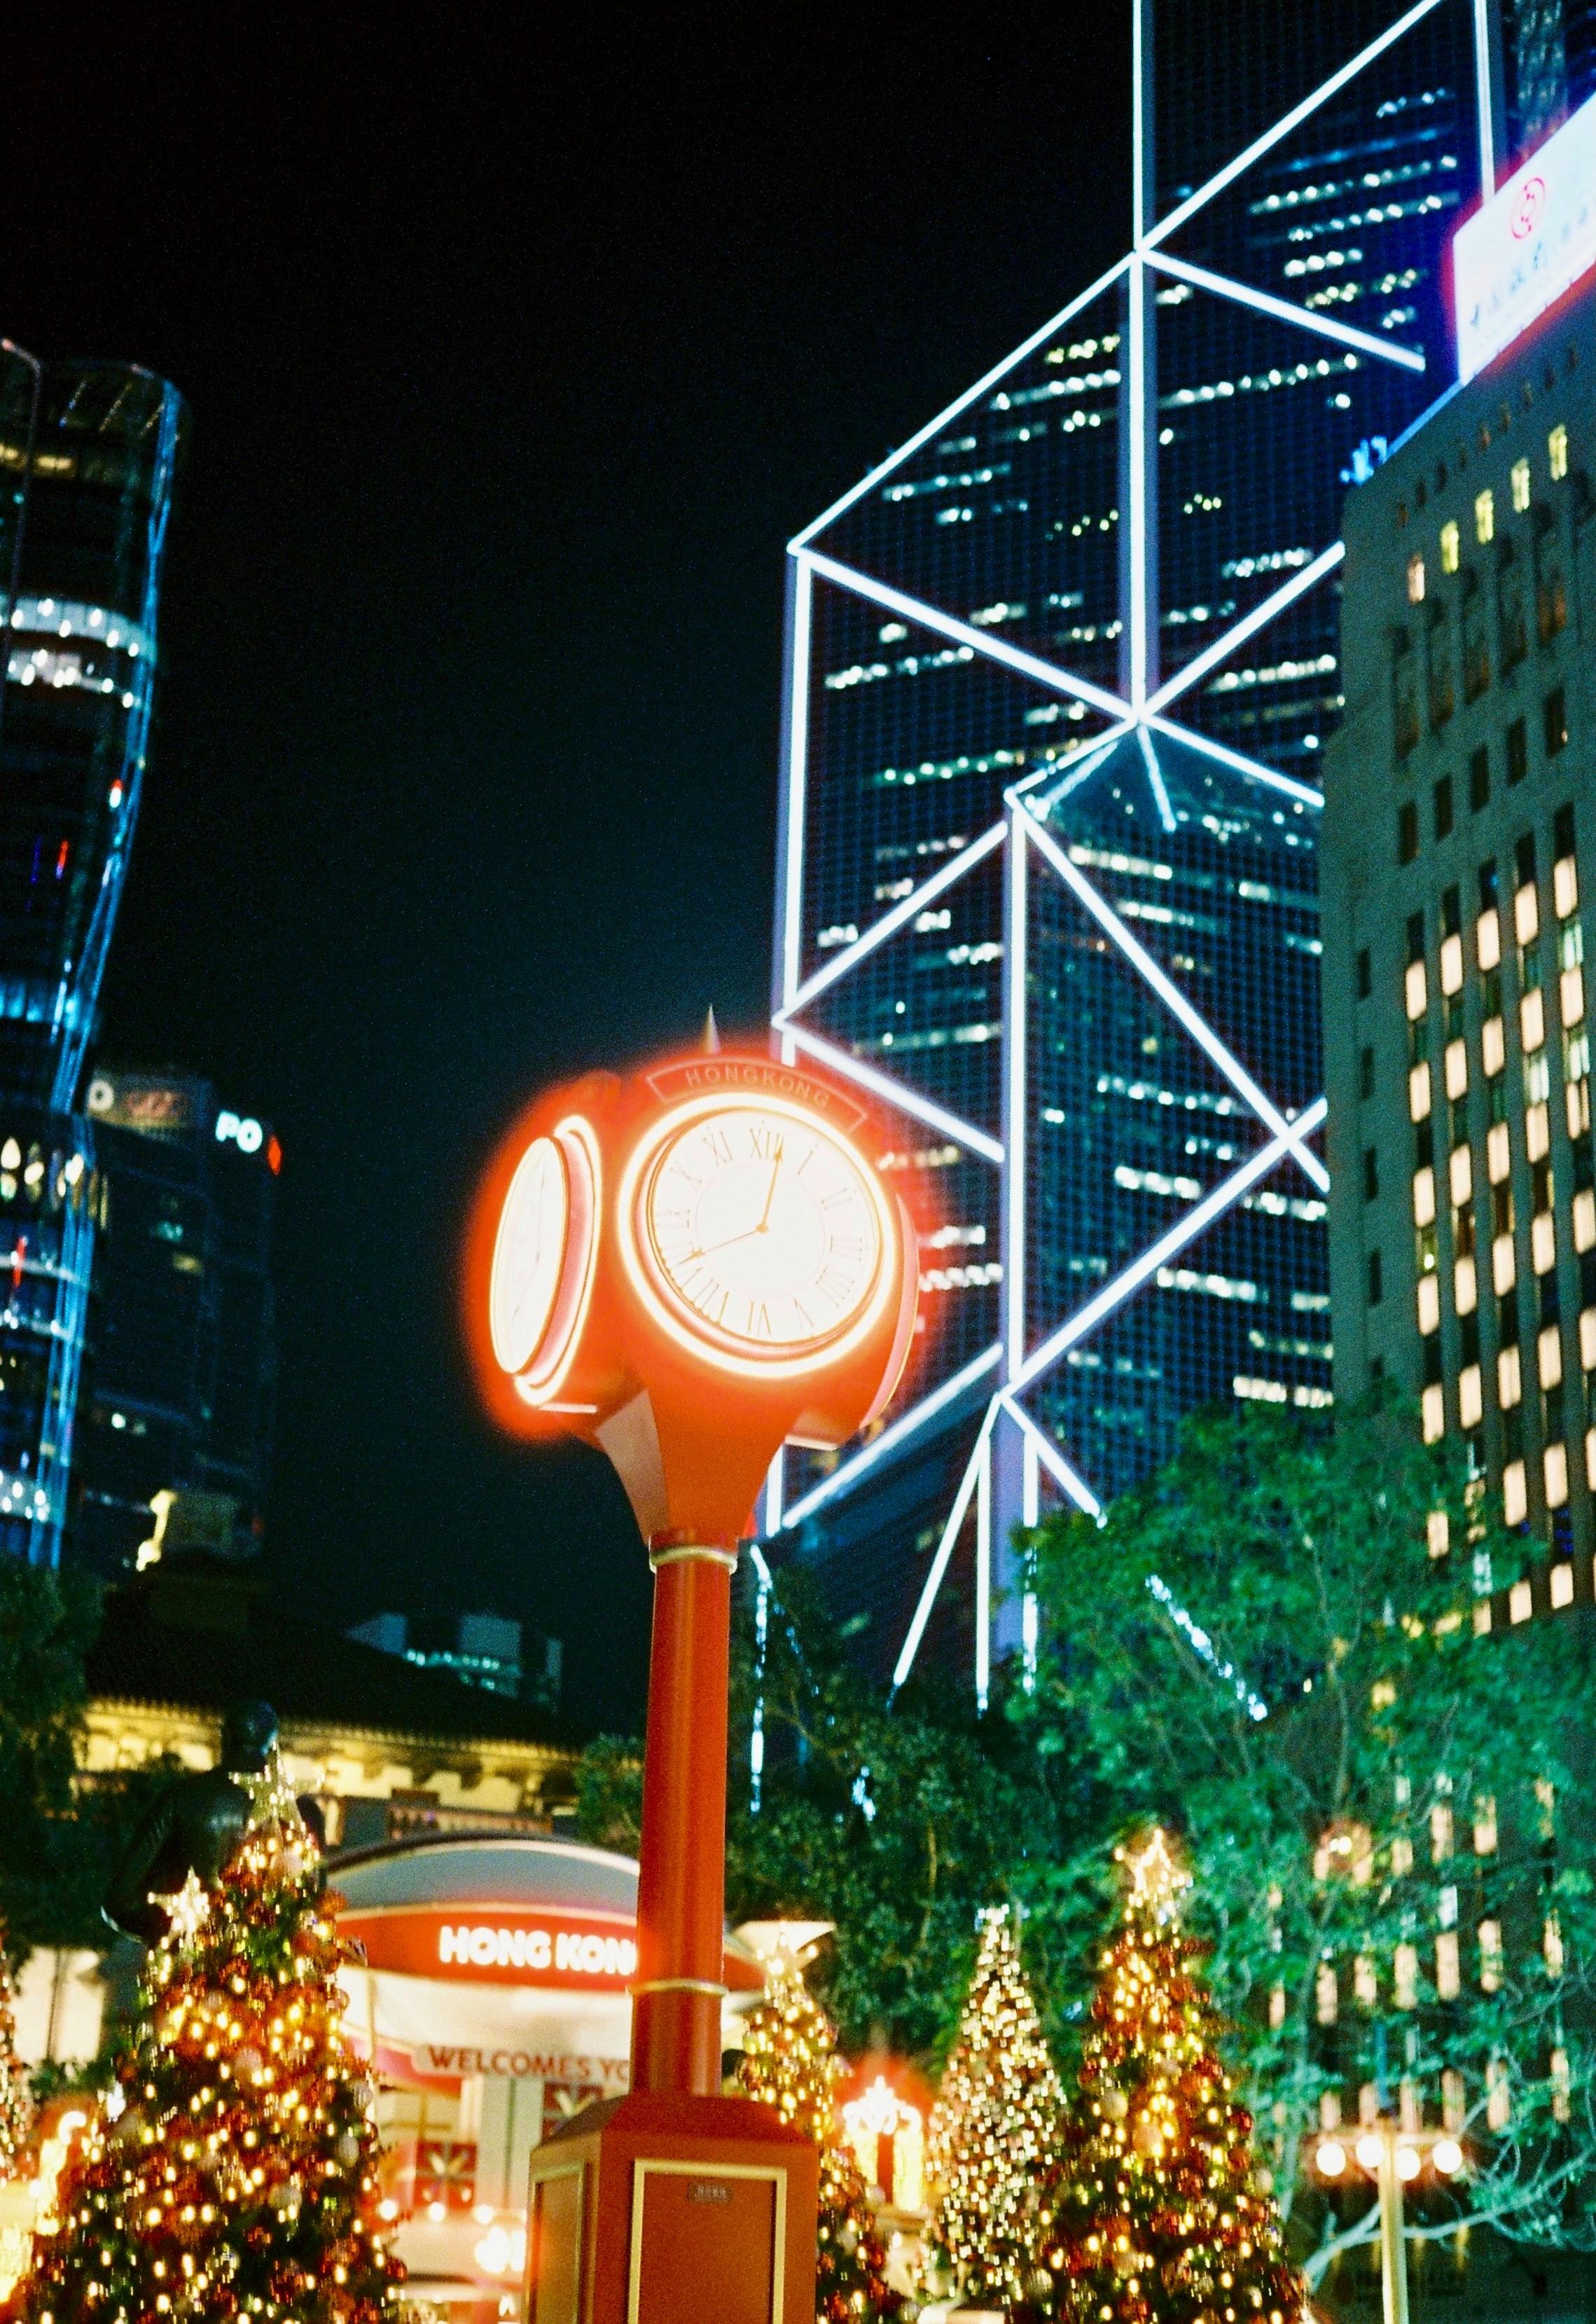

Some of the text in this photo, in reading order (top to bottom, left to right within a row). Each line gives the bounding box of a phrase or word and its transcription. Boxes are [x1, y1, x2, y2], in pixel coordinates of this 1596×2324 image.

[686, 1064, 829, 1109] HONGKONG
[702, 1130, 733, 1166] XI
[439, 1925, 638, 1976] HONG KON
[427, 2044, 590, 2082] WELCOMES
